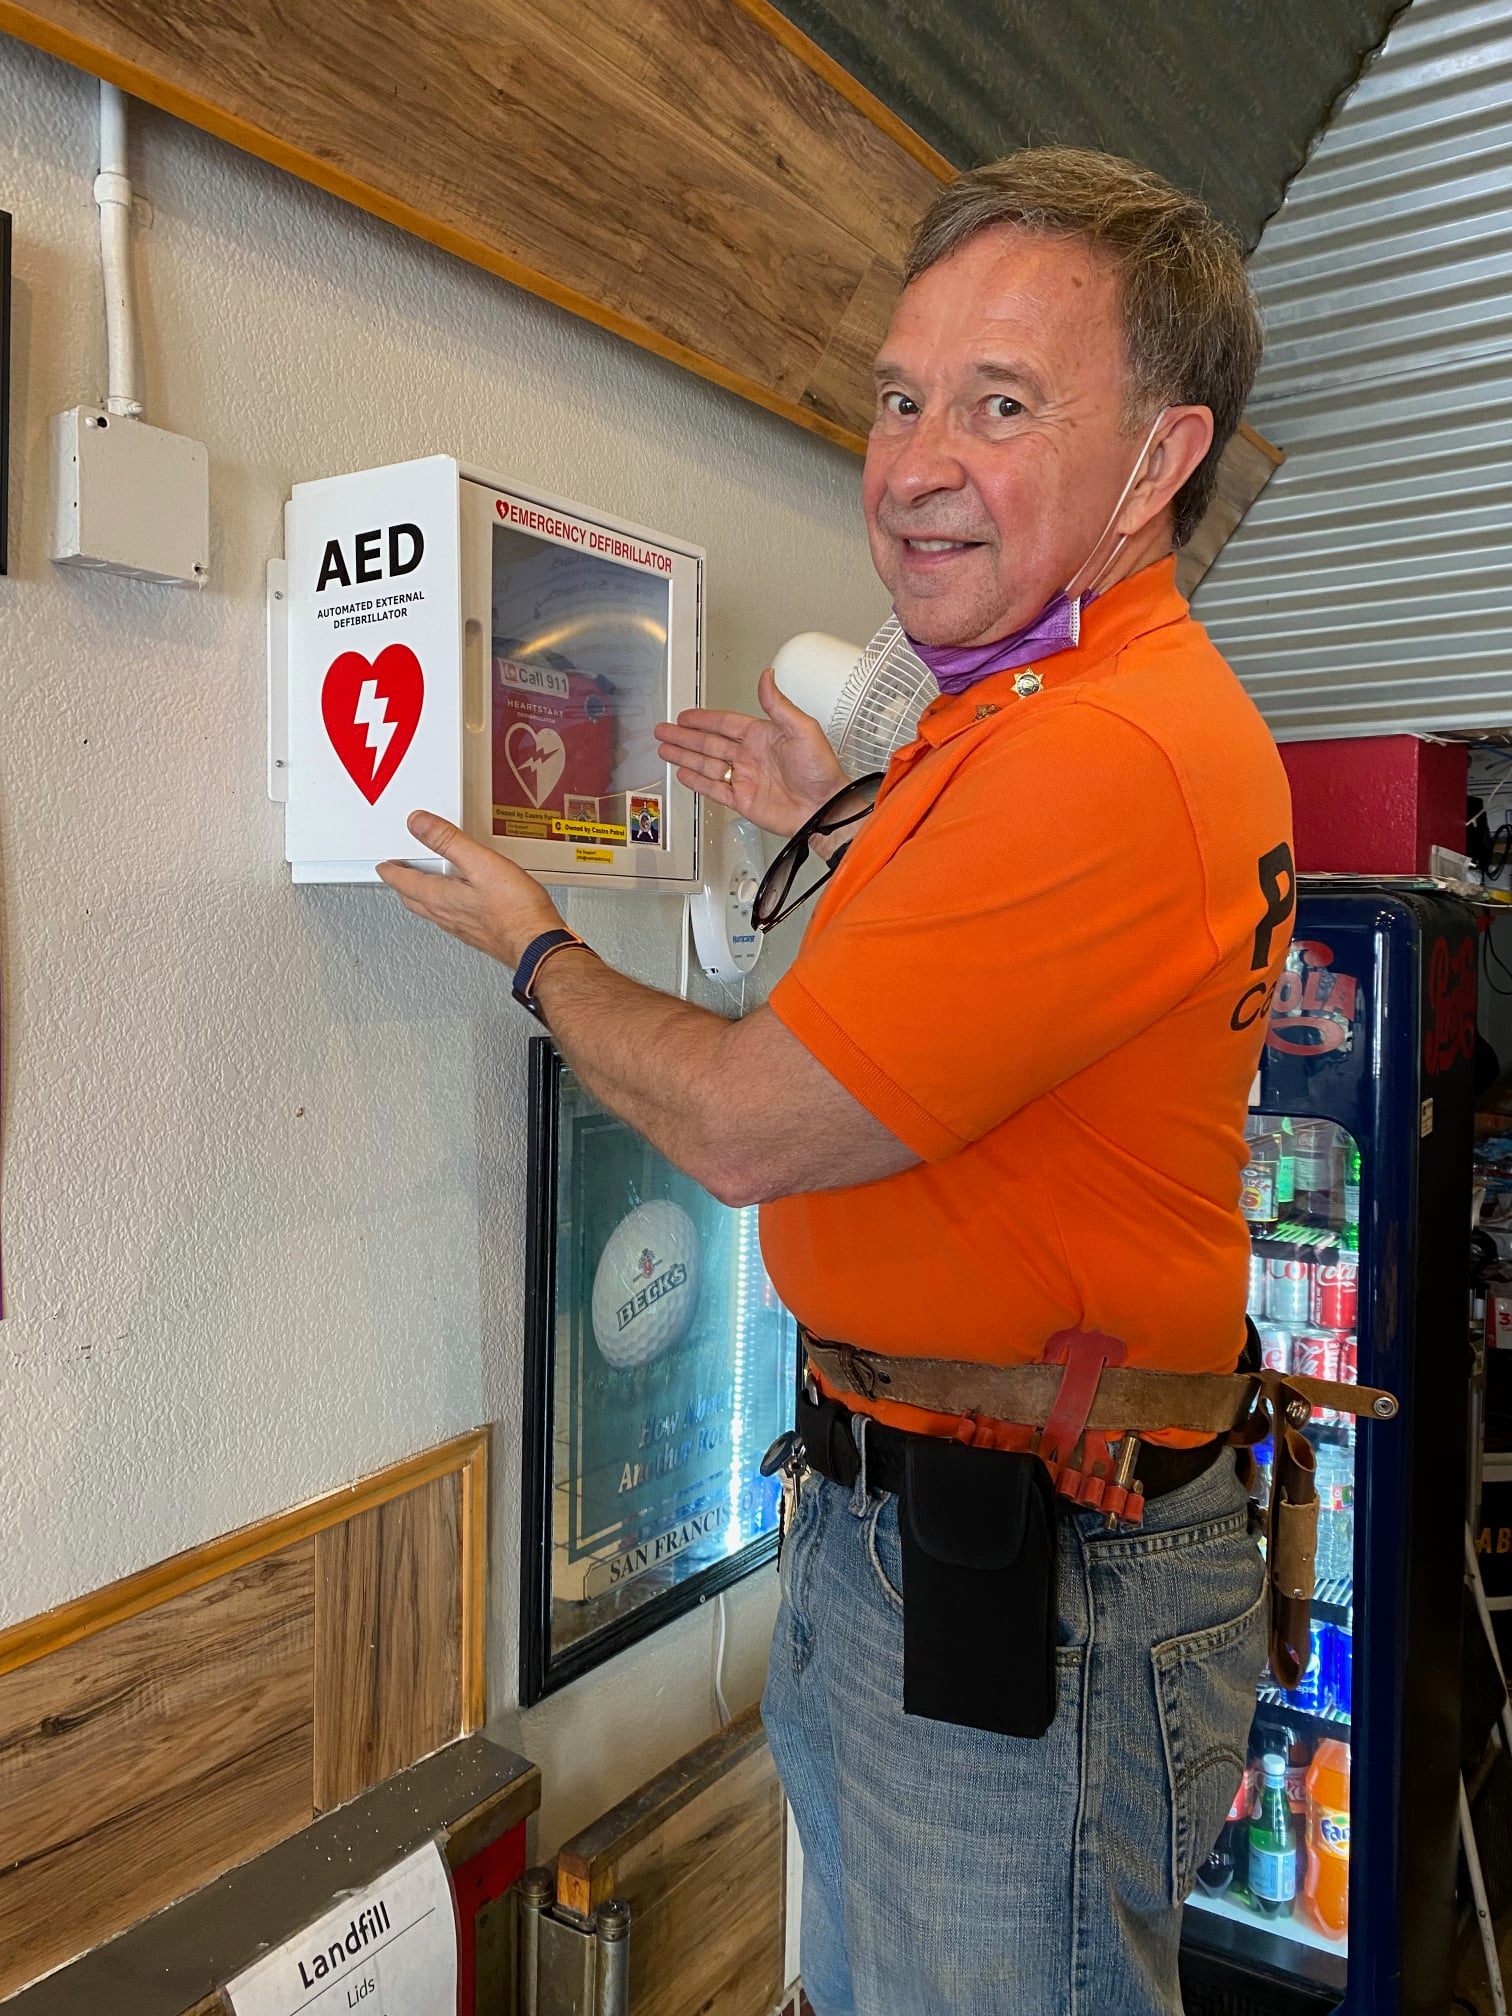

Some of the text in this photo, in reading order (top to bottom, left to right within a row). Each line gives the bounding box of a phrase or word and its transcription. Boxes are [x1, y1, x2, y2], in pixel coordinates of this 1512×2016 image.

[510, 505, 587, 543] EMERGENCY
[589, 531, 672, 573] DEFIBRILLATOR
[315, 522, 425, 593] AED
[317, 590, 425, 619] AUTOMATED EXTERNAL
[333, 607, 408, 629] DEFIBRILLATOR
[518, 668, 567, 693] Call 911
[507, 699, 563, 718] HEARTSTART
[609, 1490, 754, 1584] SAN FRANCISO
[297, 1901, 391, 1990] Landfill
[347, 1978, 375, 2009] Lids
